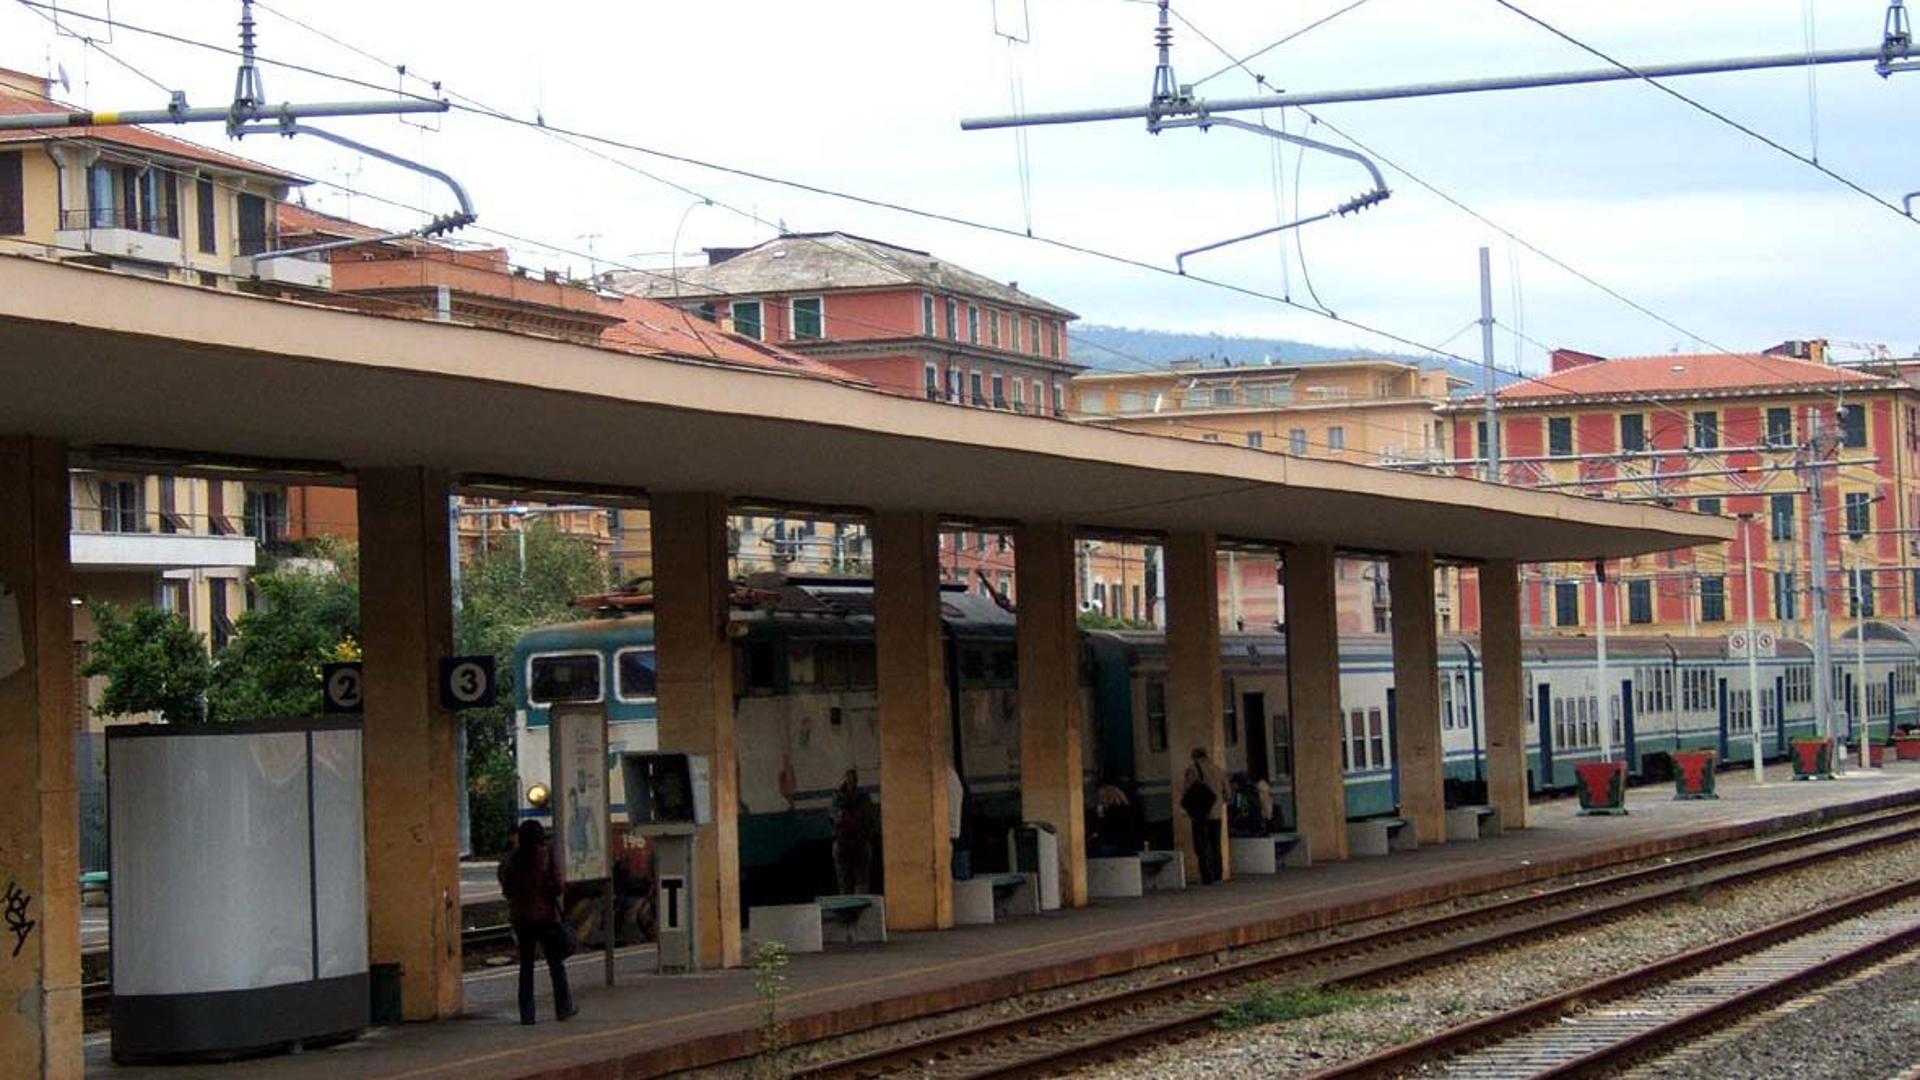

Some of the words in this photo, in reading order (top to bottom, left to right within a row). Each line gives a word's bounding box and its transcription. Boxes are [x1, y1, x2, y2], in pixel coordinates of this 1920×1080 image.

[337, 675, 358, 701] 2
[459, 668, 478, 695] 3
[661, 879, 683, 928] T
